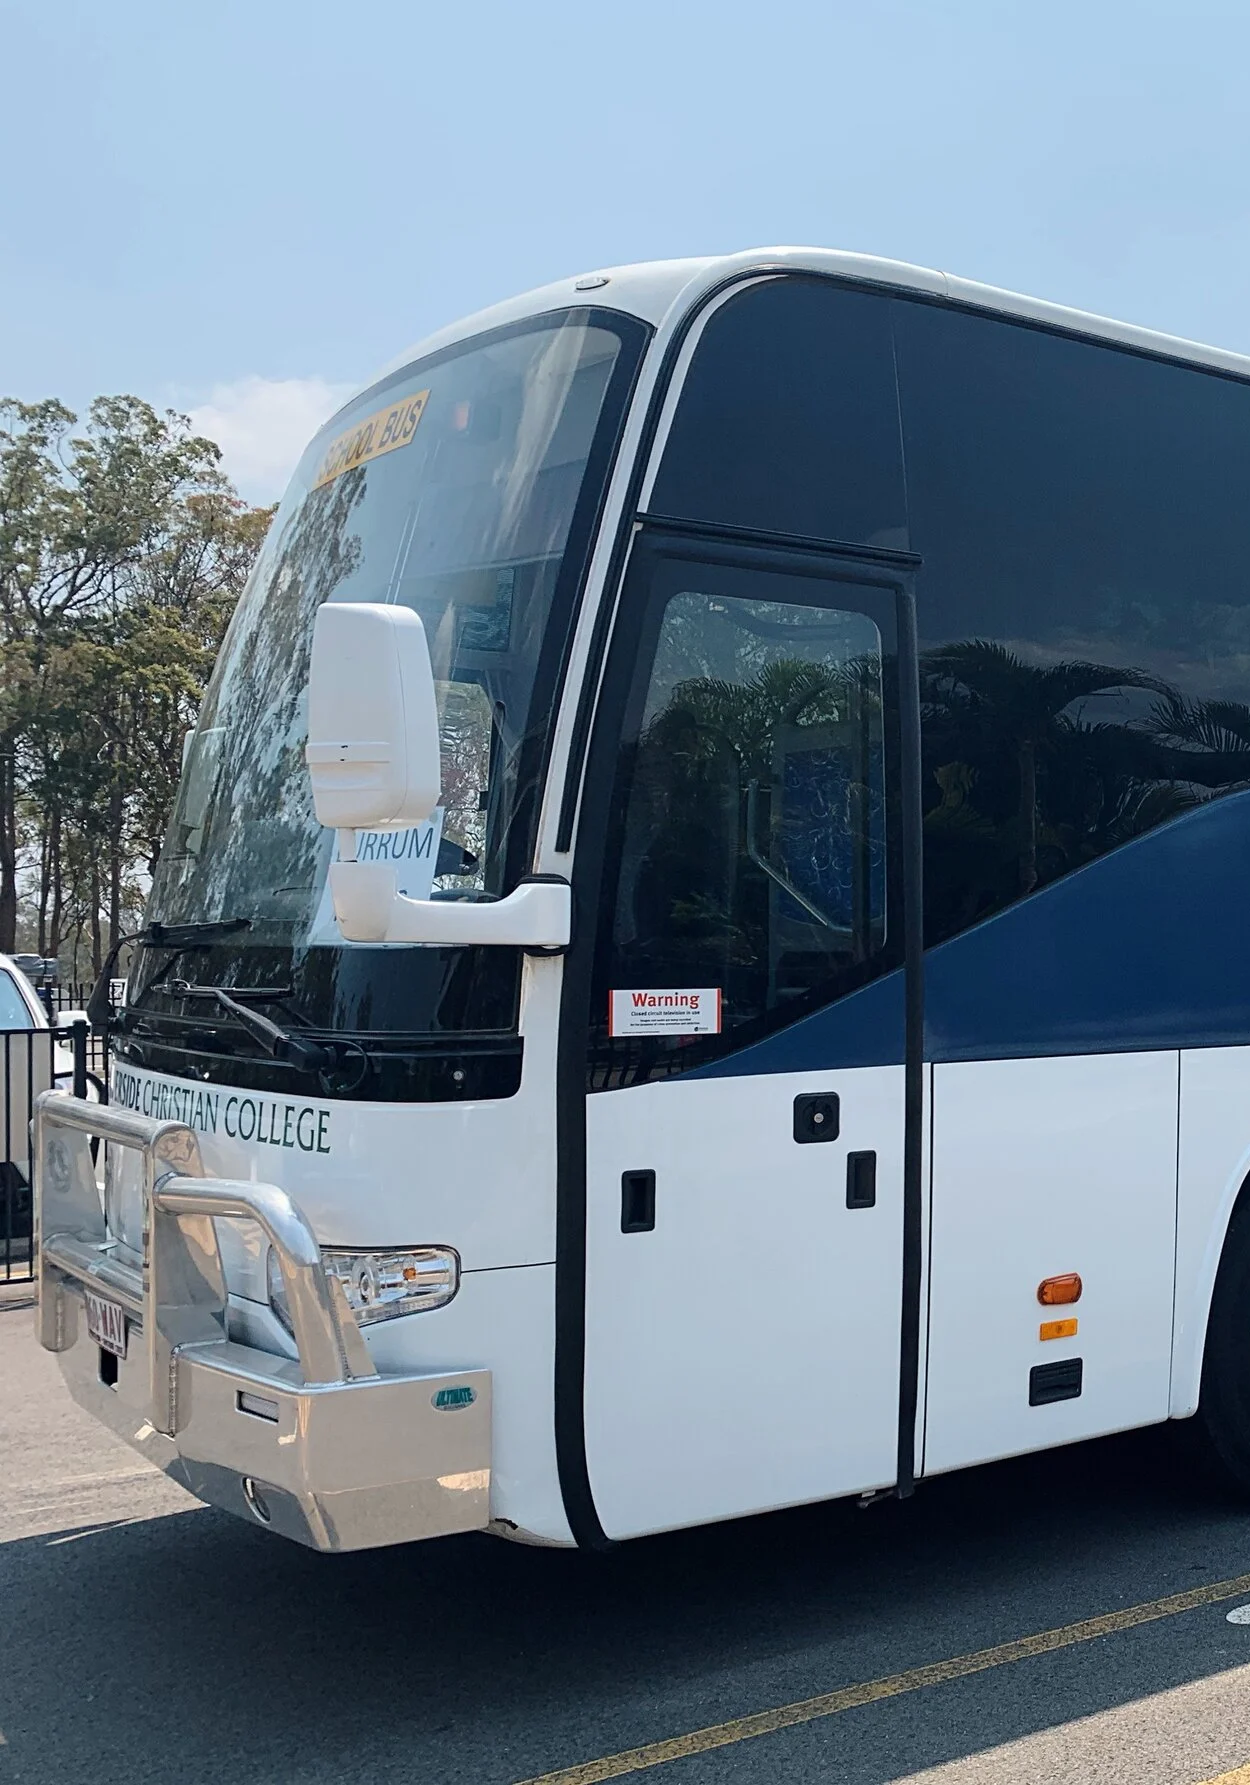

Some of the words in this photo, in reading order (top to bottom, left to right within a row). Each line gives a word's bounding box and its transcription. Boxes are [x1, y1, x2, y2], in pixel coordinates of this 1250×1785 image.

[378, 399, 422, 448] BUS
[335, 827, 434, 863] RRUM
[632, 992, 700, 1009] Warning
[143, 1079, 219, 1134] CHRISTIAN
[224, 1096, 331, 1154] COLLEGE
